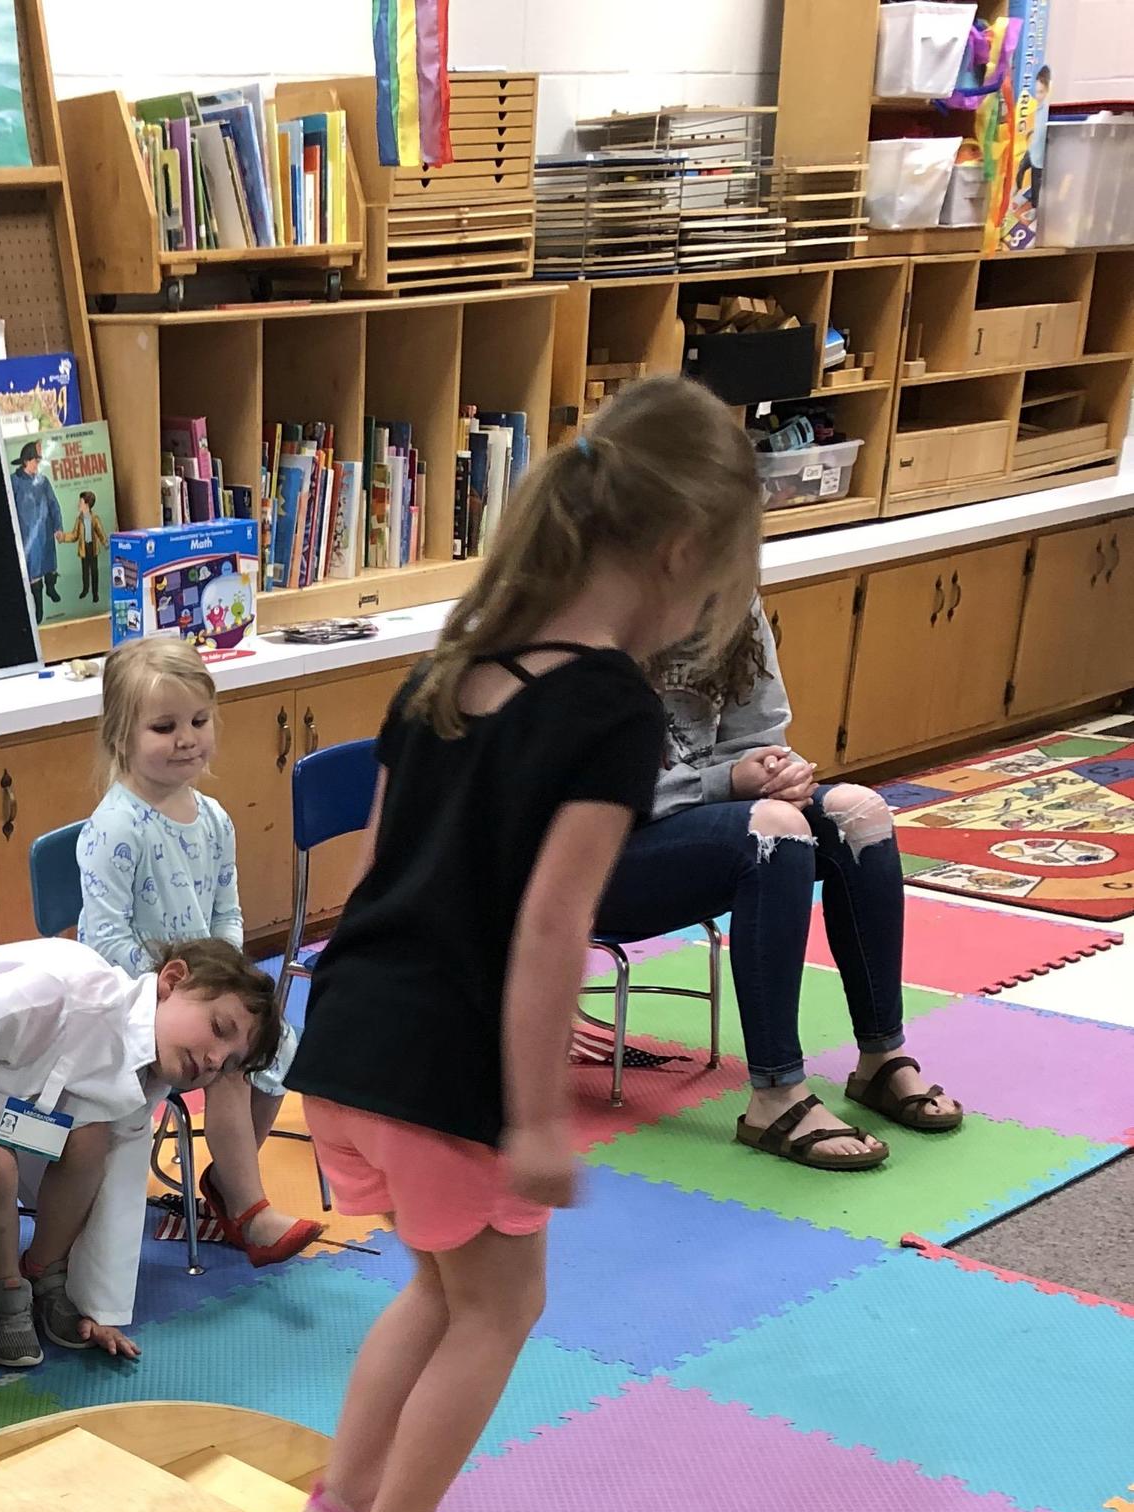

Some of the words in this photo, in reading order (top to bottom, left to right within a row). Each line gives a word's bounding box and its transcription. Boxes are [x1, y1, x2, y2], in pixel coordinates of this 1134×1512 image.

[61, 440, 83, 457] THE
[51, 453, 107, 481] FIREMAN
[190, 536, 213, 551] Math
[23, 1108, 57, 1124] LABORATORY
